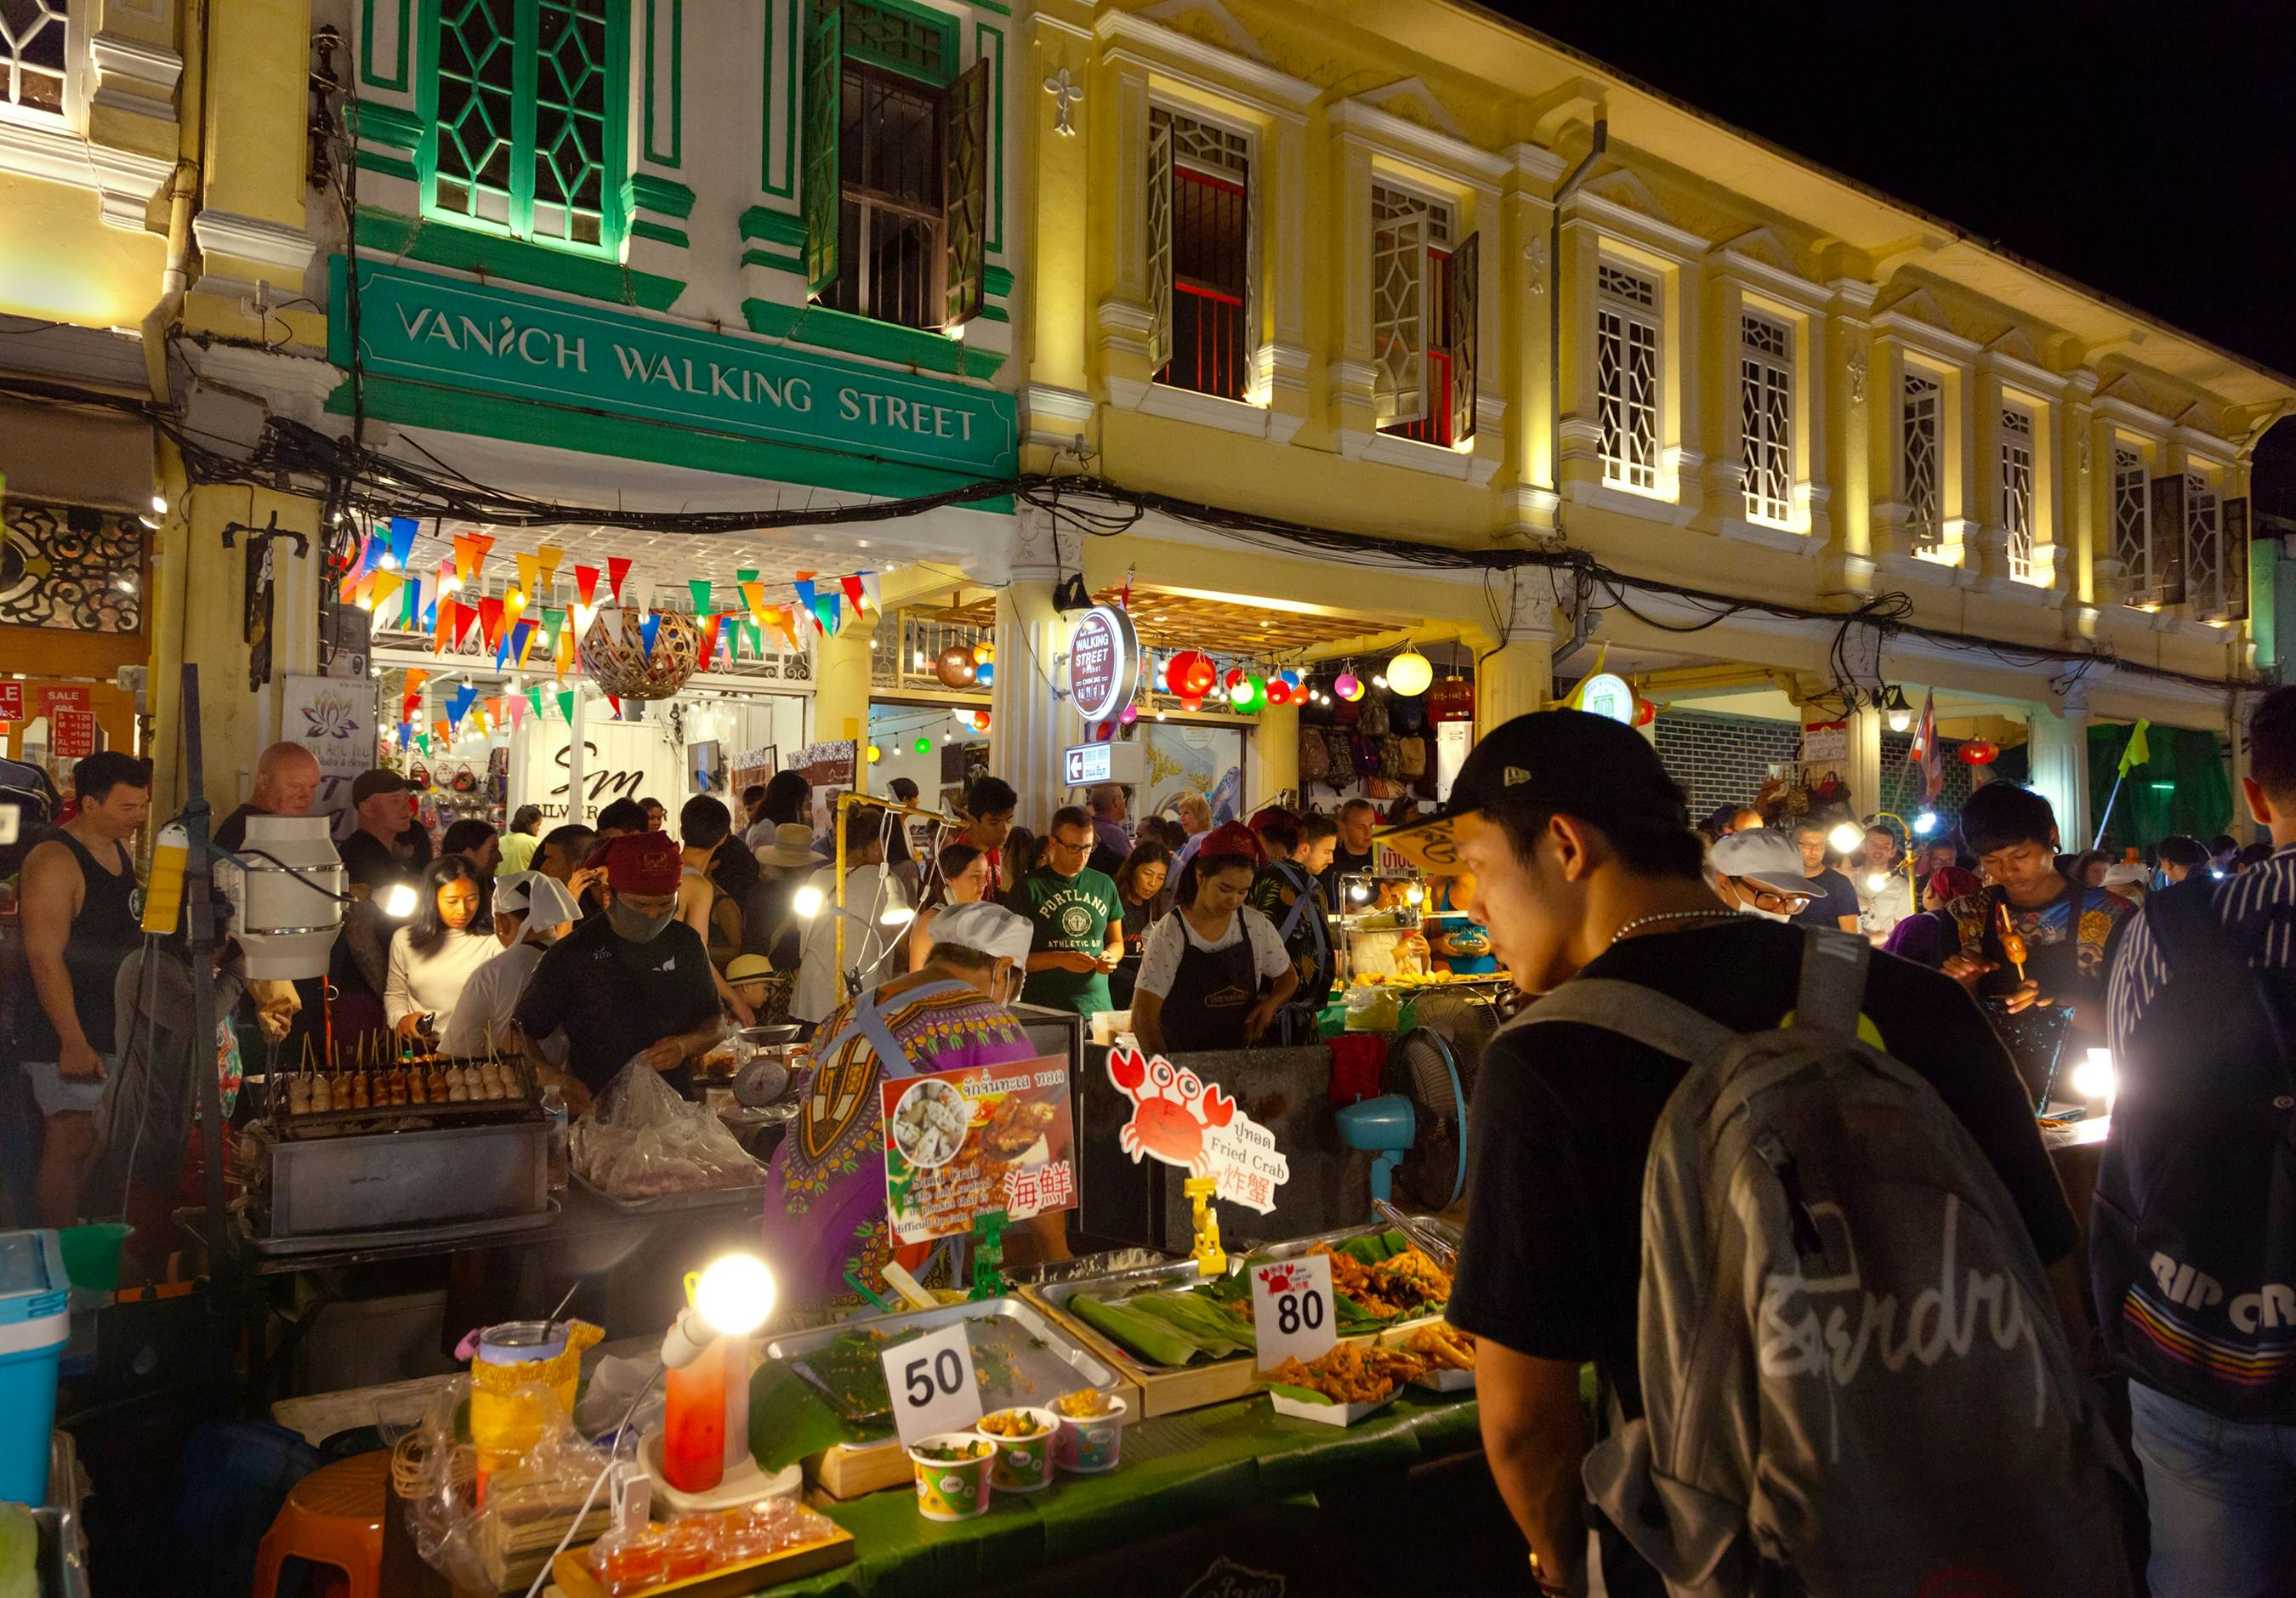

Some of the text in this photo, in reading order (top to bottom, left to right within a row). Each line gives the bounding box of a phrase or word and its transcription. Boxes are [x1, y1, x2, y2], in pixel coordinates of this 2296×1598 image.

[613, 344, 812, 412] WALKING
[838, 388, 976, 441] STREET
[1076, 634, 1109, 651] WALKING
[1075, 648, 1109, 667] STREET
[48, 691, 79, 701] SALE
[531, 804, 598, 820] SILVR
[1039, 889, 1108, 919] PORTLAND
[1048, 940, 1089, 948] ATHLETIC
[1036, 1069, 1064, 1086] ทอด
[1234, 1122, 1271, 1150] ปูทอด
[1210, 1136, 1285, 1180] Fried Crab
[912, 1162, 980, 1190] Sand Crab
[1003, 1160, 1072, 1214] 海鮮
[915, 1191, 932, 1203] the
[895, 1218, 931, 1235] difficult
[2150, 1250, 2223, 1311] RIP
[1278, 1289, 1323, 1335] 80
[905, 1348, 964, 1407] 50
